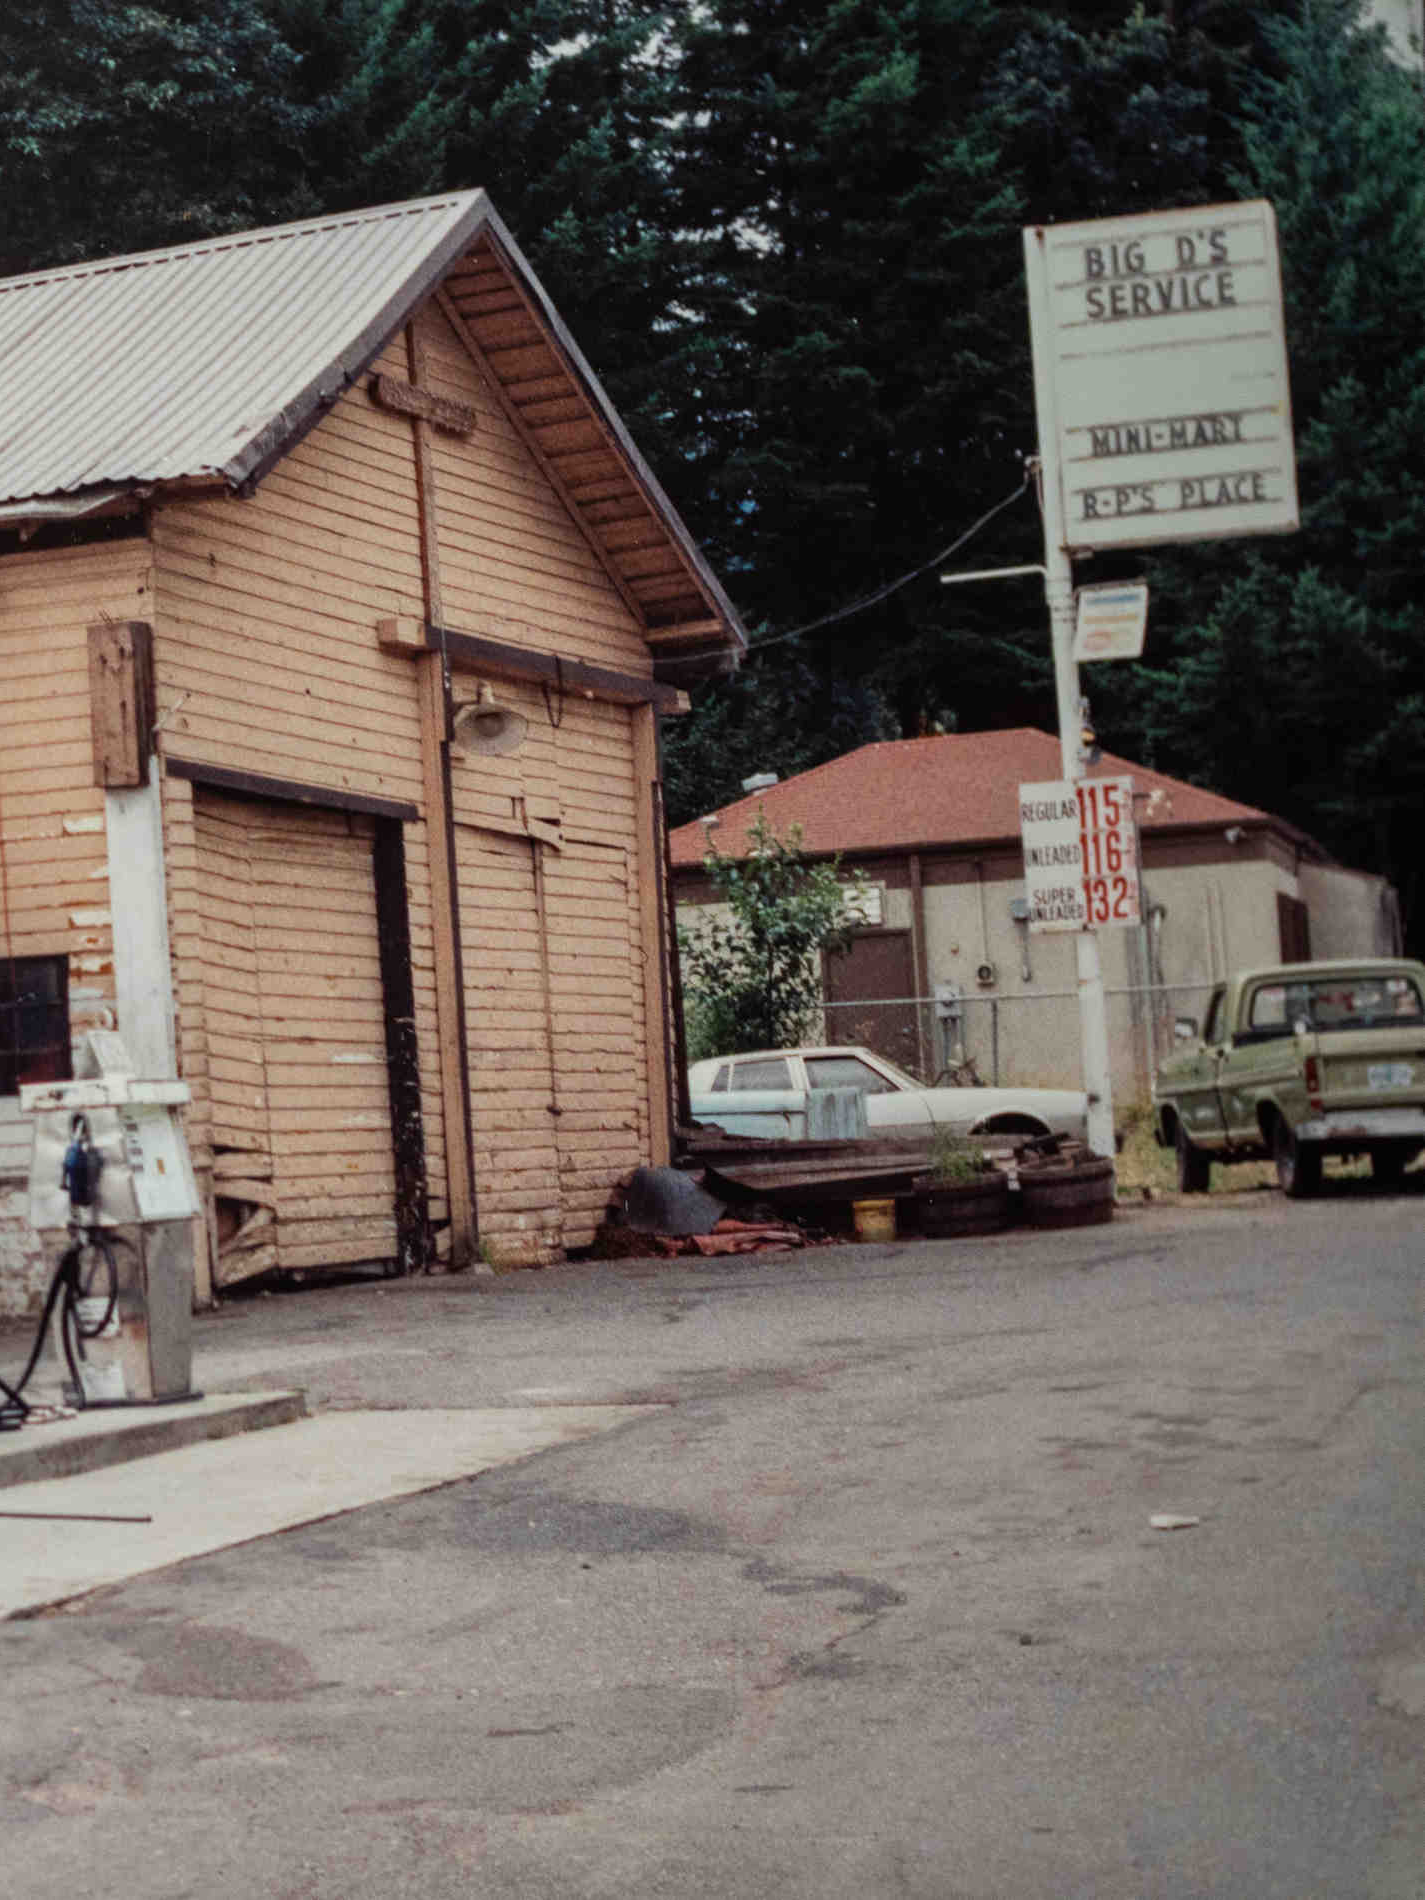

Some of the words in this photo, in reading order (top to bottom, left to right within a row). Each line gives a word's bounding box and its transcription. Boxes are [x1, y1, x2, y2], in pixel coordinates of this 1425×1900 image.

[1085, 242, 1146, 281] BIG
[1176, 230, 1229, 268] D'S
[1086, 271, 1237, 319] SERVICE
[1179, 471, 1267, 509] PLACE
[1022, 799, 1077, 822] REGULAR
[1076, 784, 1120, 828] 115
[1025, 845, 1080, 866] UNLEADED
[1080, 829, 1122, 875] 116
[1033, 887, 1075, 905] SUPER
[1083, 876, 1128, 922] 132
